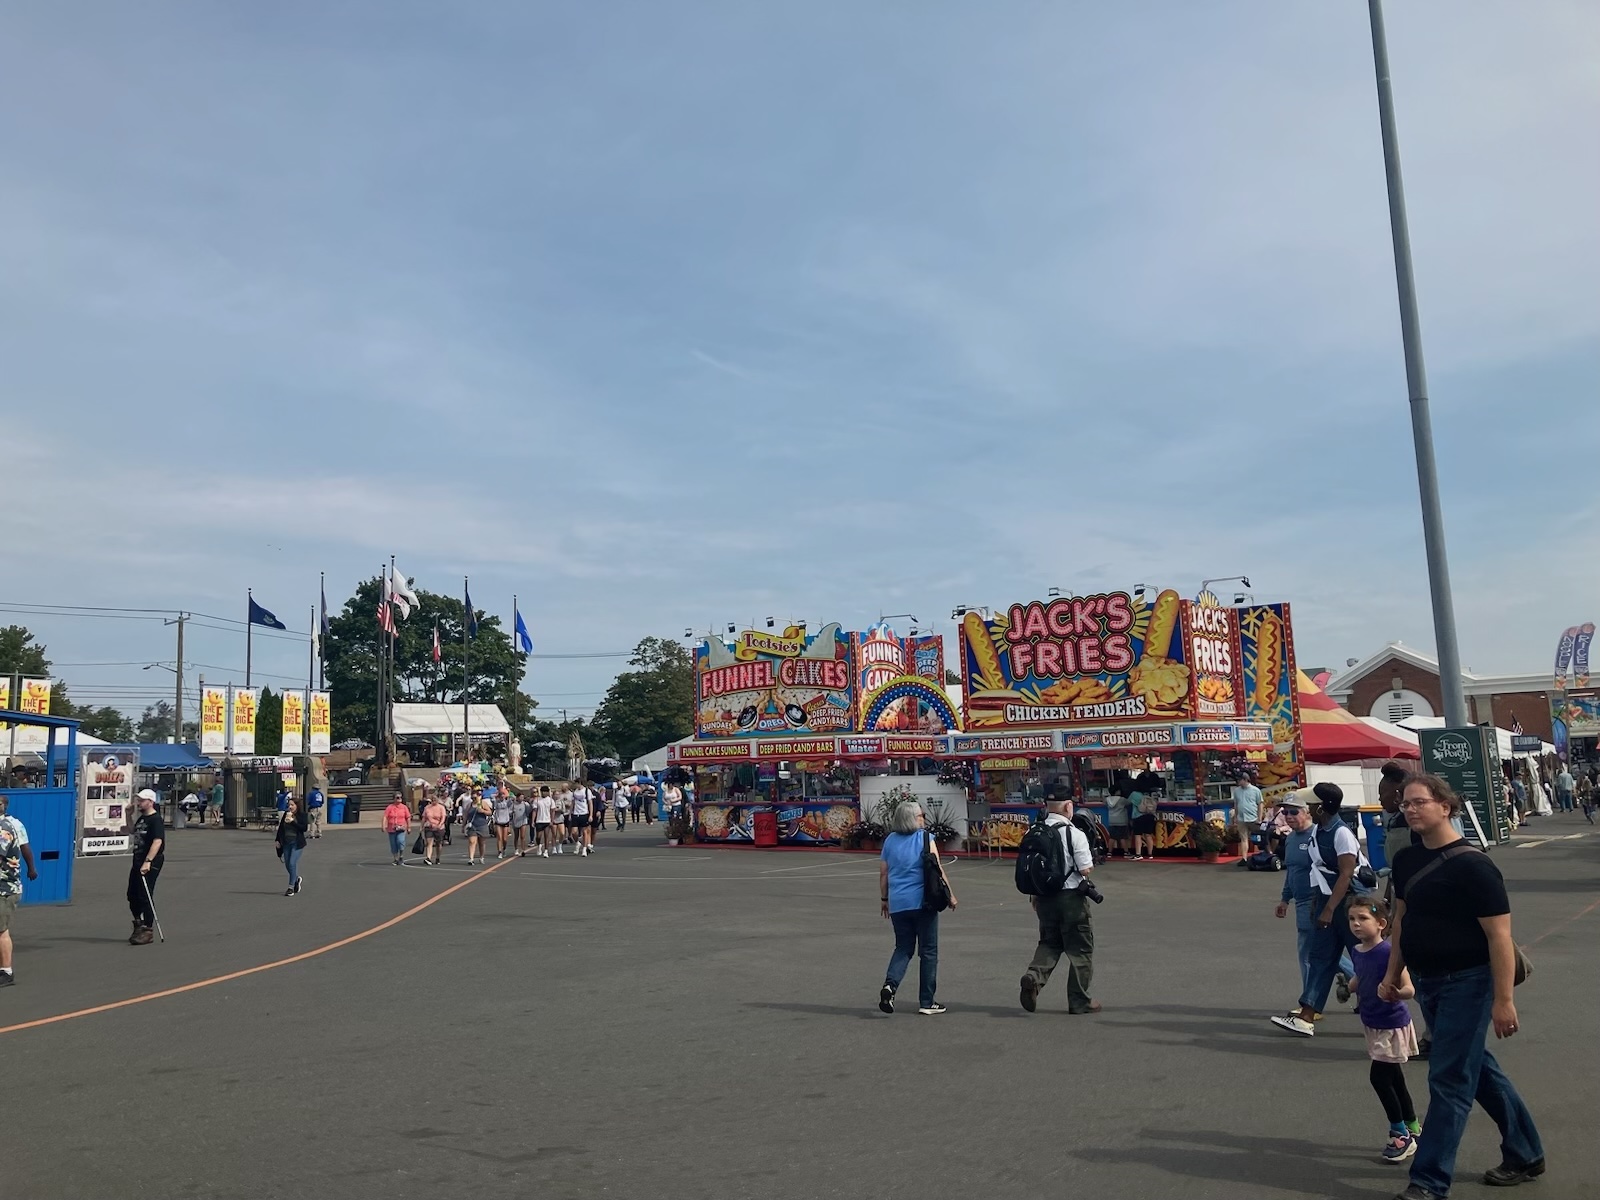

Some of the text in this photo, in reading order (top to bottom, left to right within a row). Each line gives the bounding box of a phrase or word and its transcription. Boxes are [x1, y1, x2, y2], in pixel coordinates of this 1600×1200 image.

[1007, 596, 1131, 641] JACK'S
[1191, 605, 1229, 635] JACK'S
[743, 633, 798, 652] Tootsie's
[1576, 634, 1589, 664] RICE
[862, 642, 905, 671] FUNNEL
[1011, 635, 1131, 676] FRIES
[1193, 636, 1231, 674] FRIES
[917, 659, 937, 667] DEEP
[918, 666, 937, 675] FRIED
[701, 659, 847, 698] FUNNEL CAKES
[867, 669, 900, 691] CAK
[22, 698, 38, 707] THE
[204, 705, 216, 713] THE
[1006, 696, 1146, 722] CHICKEN TENDERS
[203, 706, 224, 723] BIG E
[235, 706, 246, 714] THE
[235, 707, 254, 724] BIG E
[284, 707, 295, 716] THE
[284, 708, 302, 725] BIG E
[311, 708, 322, 716] THE
[812, 708, 845, 718] DEEP FRIED
[311, 709, 329, 726] BIG E
[758, 718, 785, 729] OREO
[809, 716, 849, 727] CANDY BARS
[701, 721, 733, 732] SUNDAES
[981, 737, 1021, 750] FRENCH
[1021, 736, 1052, 749] FRIES
[1101, 731, 1135, 745] CORN
[1138, 730, 1171, 743] DOGS
[1189, 732, 1230, 741] DRINKS
[682, 746, 705, 757] FUNNEL
[704, 746, 720, 756] CAKE
[720, 745, 748, 756] SUNDAES
[759, 742, 833, 755] DEEP FRIED CANDY BARS
[847, 744, 879, 753] Water
[888, 740, 912, 751] FUNNEL
[913, 741, 932, 751] CAKES
[1438, 738, 1468, 752] Front
[251, 757, 275, 766] EXIT
[1444, 749, 1470, 762] Porch
[778, 808, 803, 822] SNICKERS
[990, 812, 1030, 825] ENCH FRIES
[1162, 811, 1185, 824] DOGS
[87, 838, 125, 848] BOOT BARN
